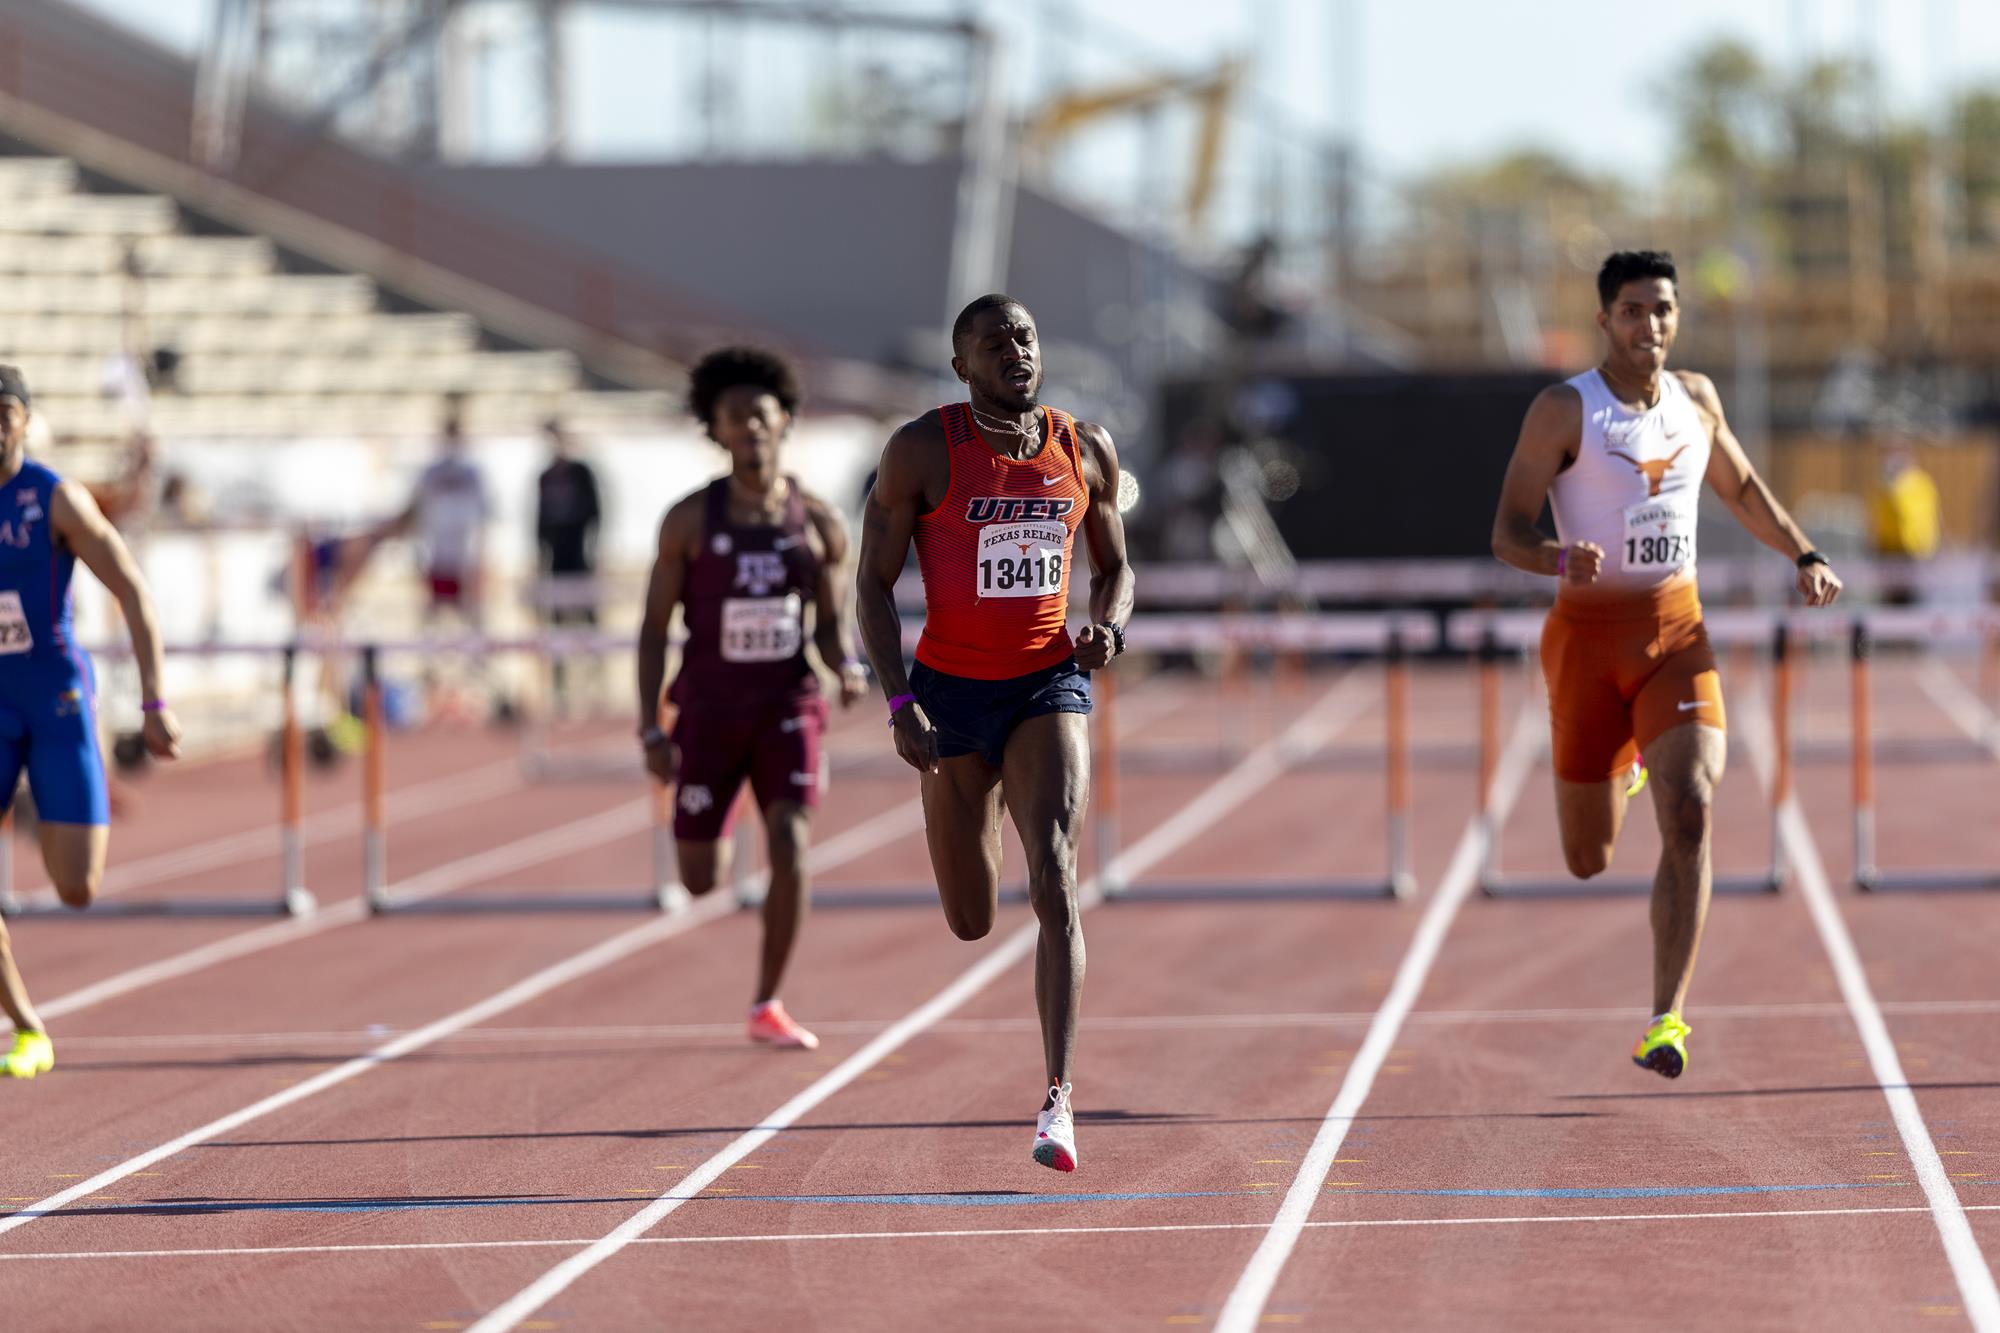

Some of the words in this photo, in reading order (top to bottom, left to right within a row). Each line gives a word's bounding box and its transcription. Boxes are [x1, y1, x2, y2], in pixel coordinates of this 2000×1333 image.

[965, 496, 1074, 523] UTEP
[983, 529, 1021, 549] TEXAS
[1022, 528, 1063, 545] RELAYS
[979, 554, 1063, 590] 13418
